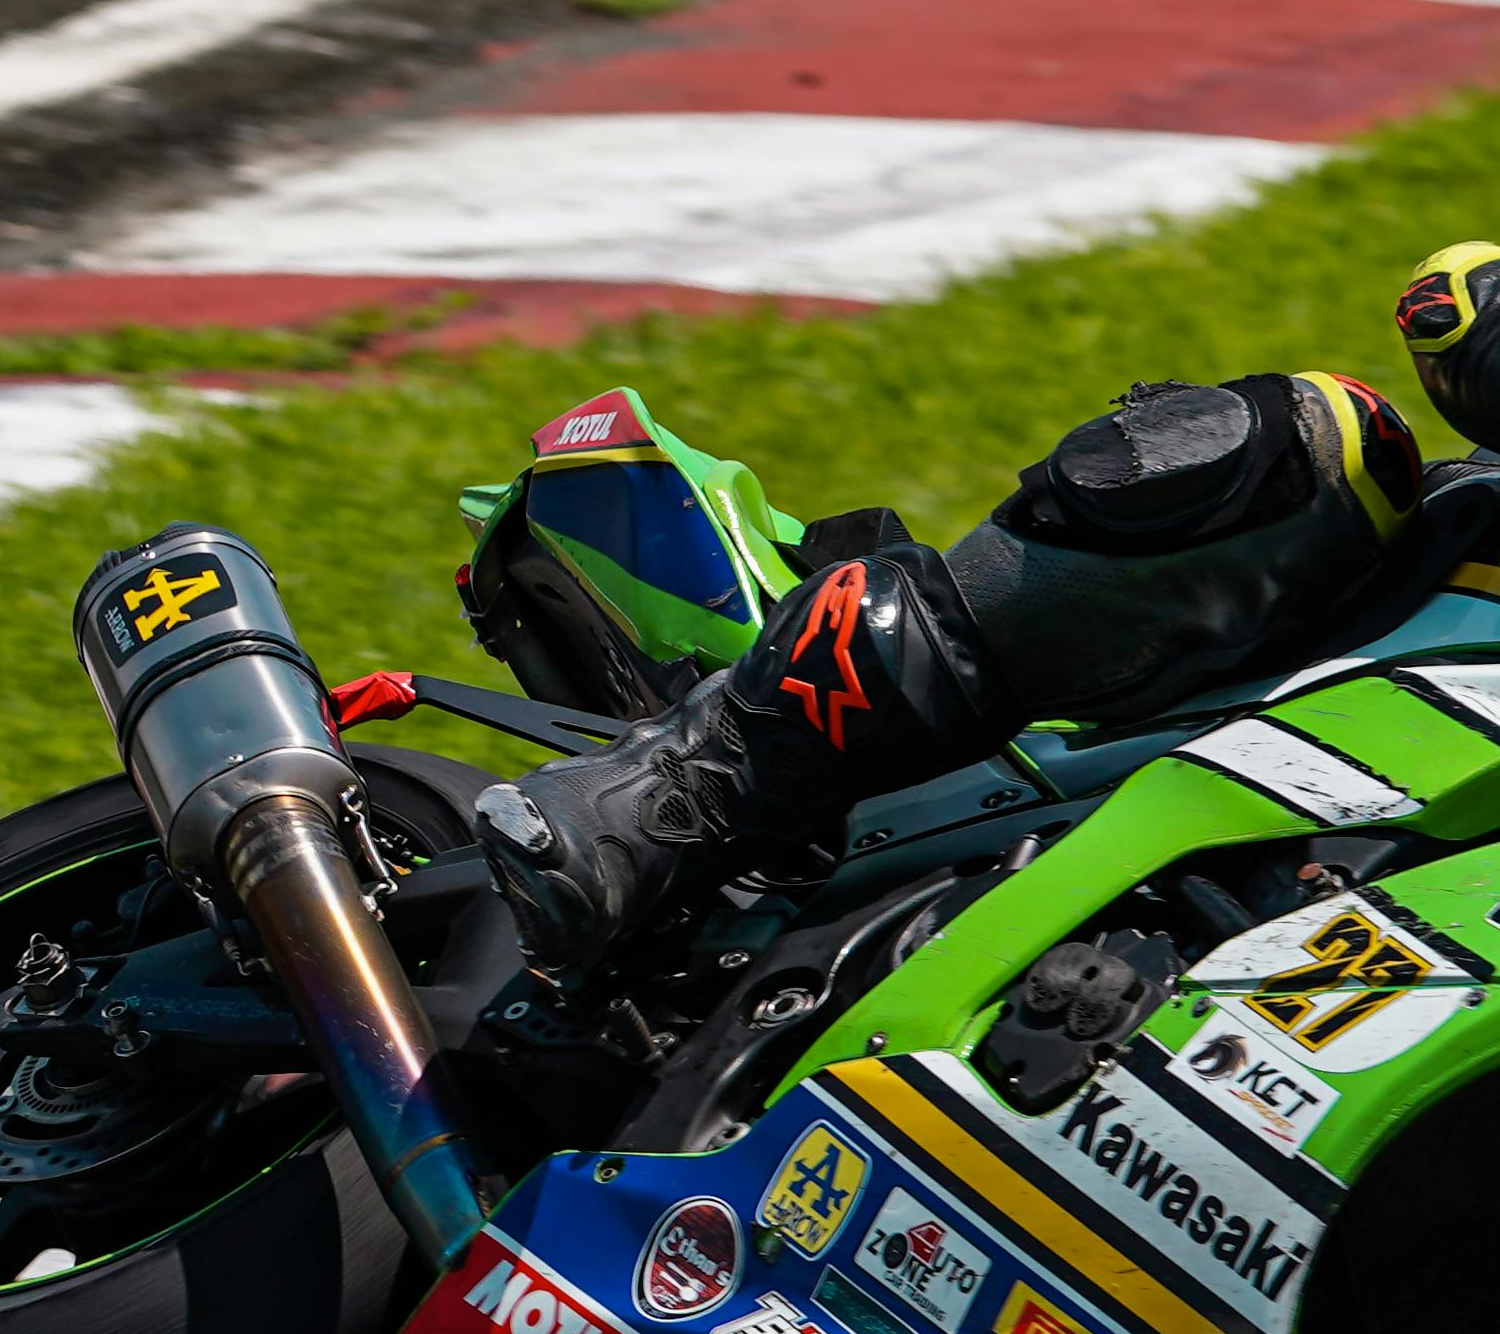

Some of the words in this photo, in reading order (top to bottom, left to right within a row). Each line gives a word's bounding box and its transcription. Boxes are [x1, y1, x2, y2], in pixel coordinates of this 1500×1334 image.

[553, 411, 618, 446] MOTUL
[1240, 911, 1436, 1054] 27
[1058, 1081, 1314, 1303] Kawasaki
